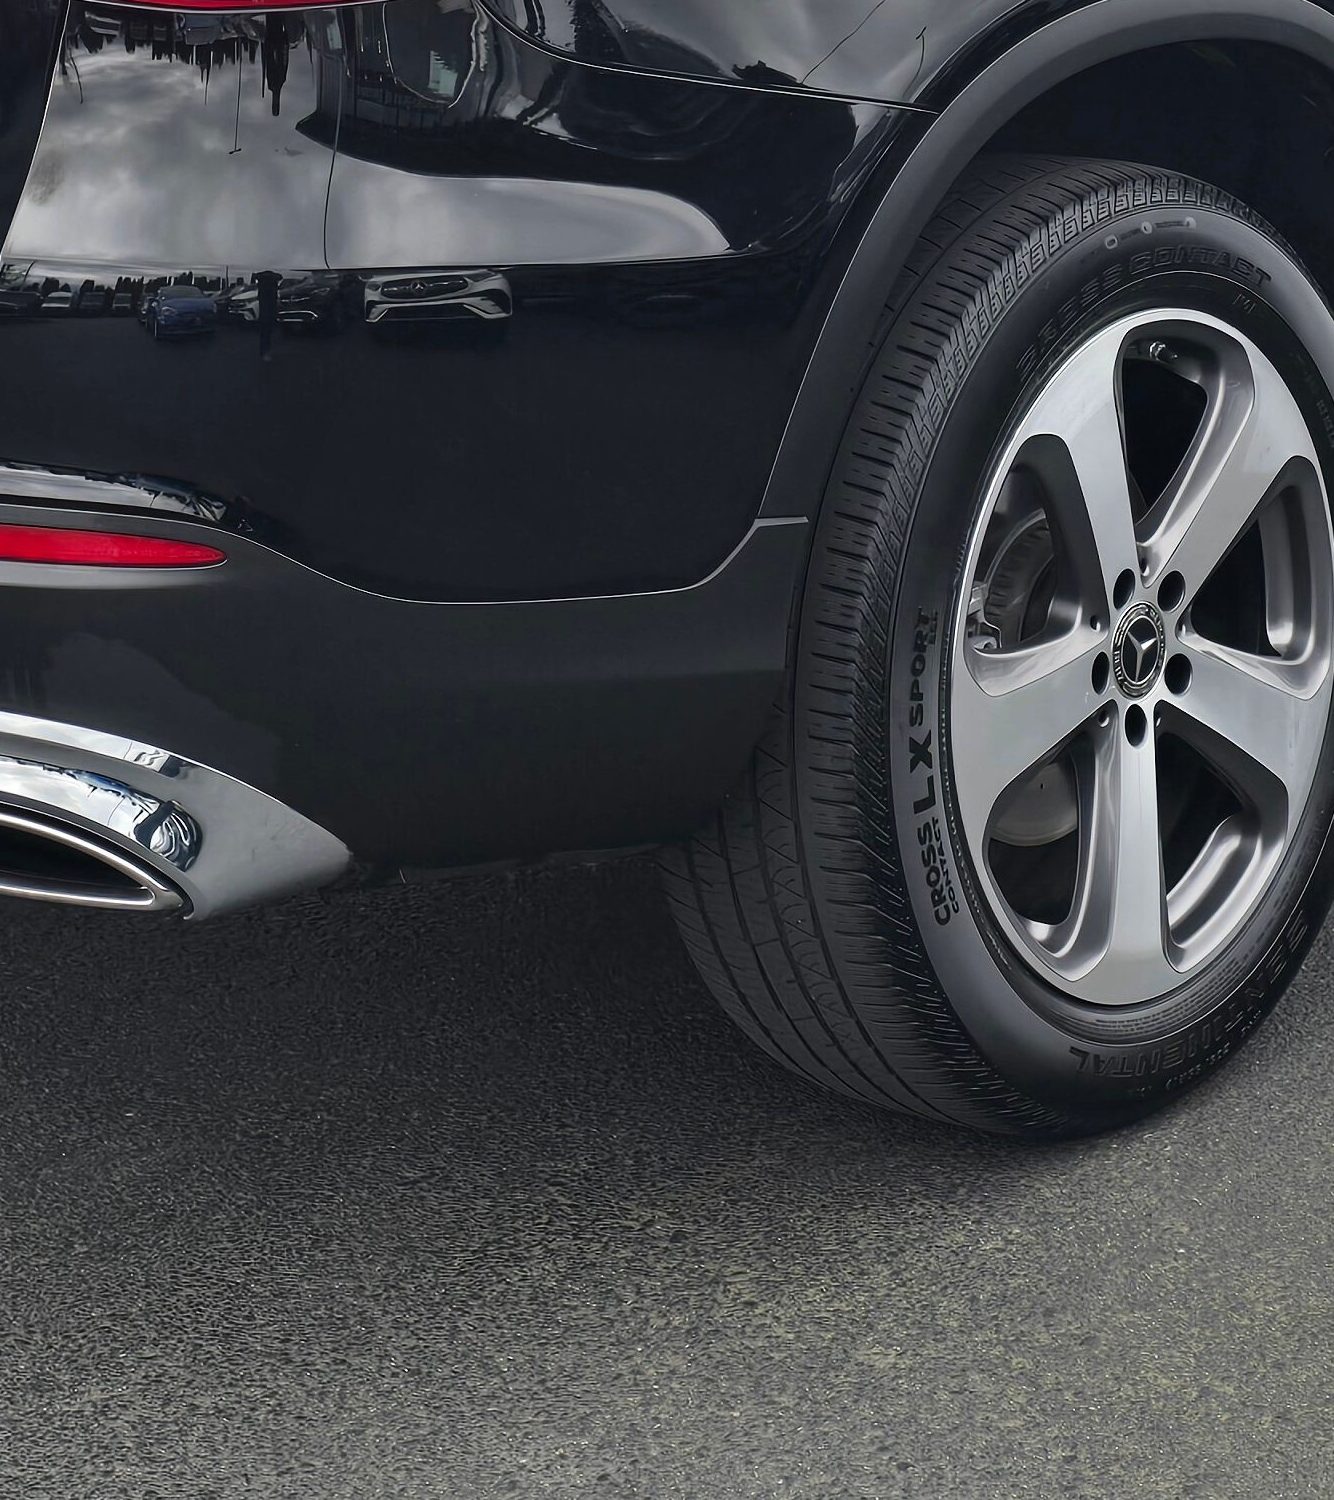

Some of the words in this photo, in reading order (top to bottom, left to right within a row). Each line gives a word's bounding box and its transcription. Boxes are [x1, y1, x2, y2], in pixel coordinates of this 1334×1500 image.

[909, 606, 930, 727] SPORT
[908, 729, 936, 815] LX
[917, 821, 951, 926] CROSS
[931, 816, 960, 915] CONTACT
